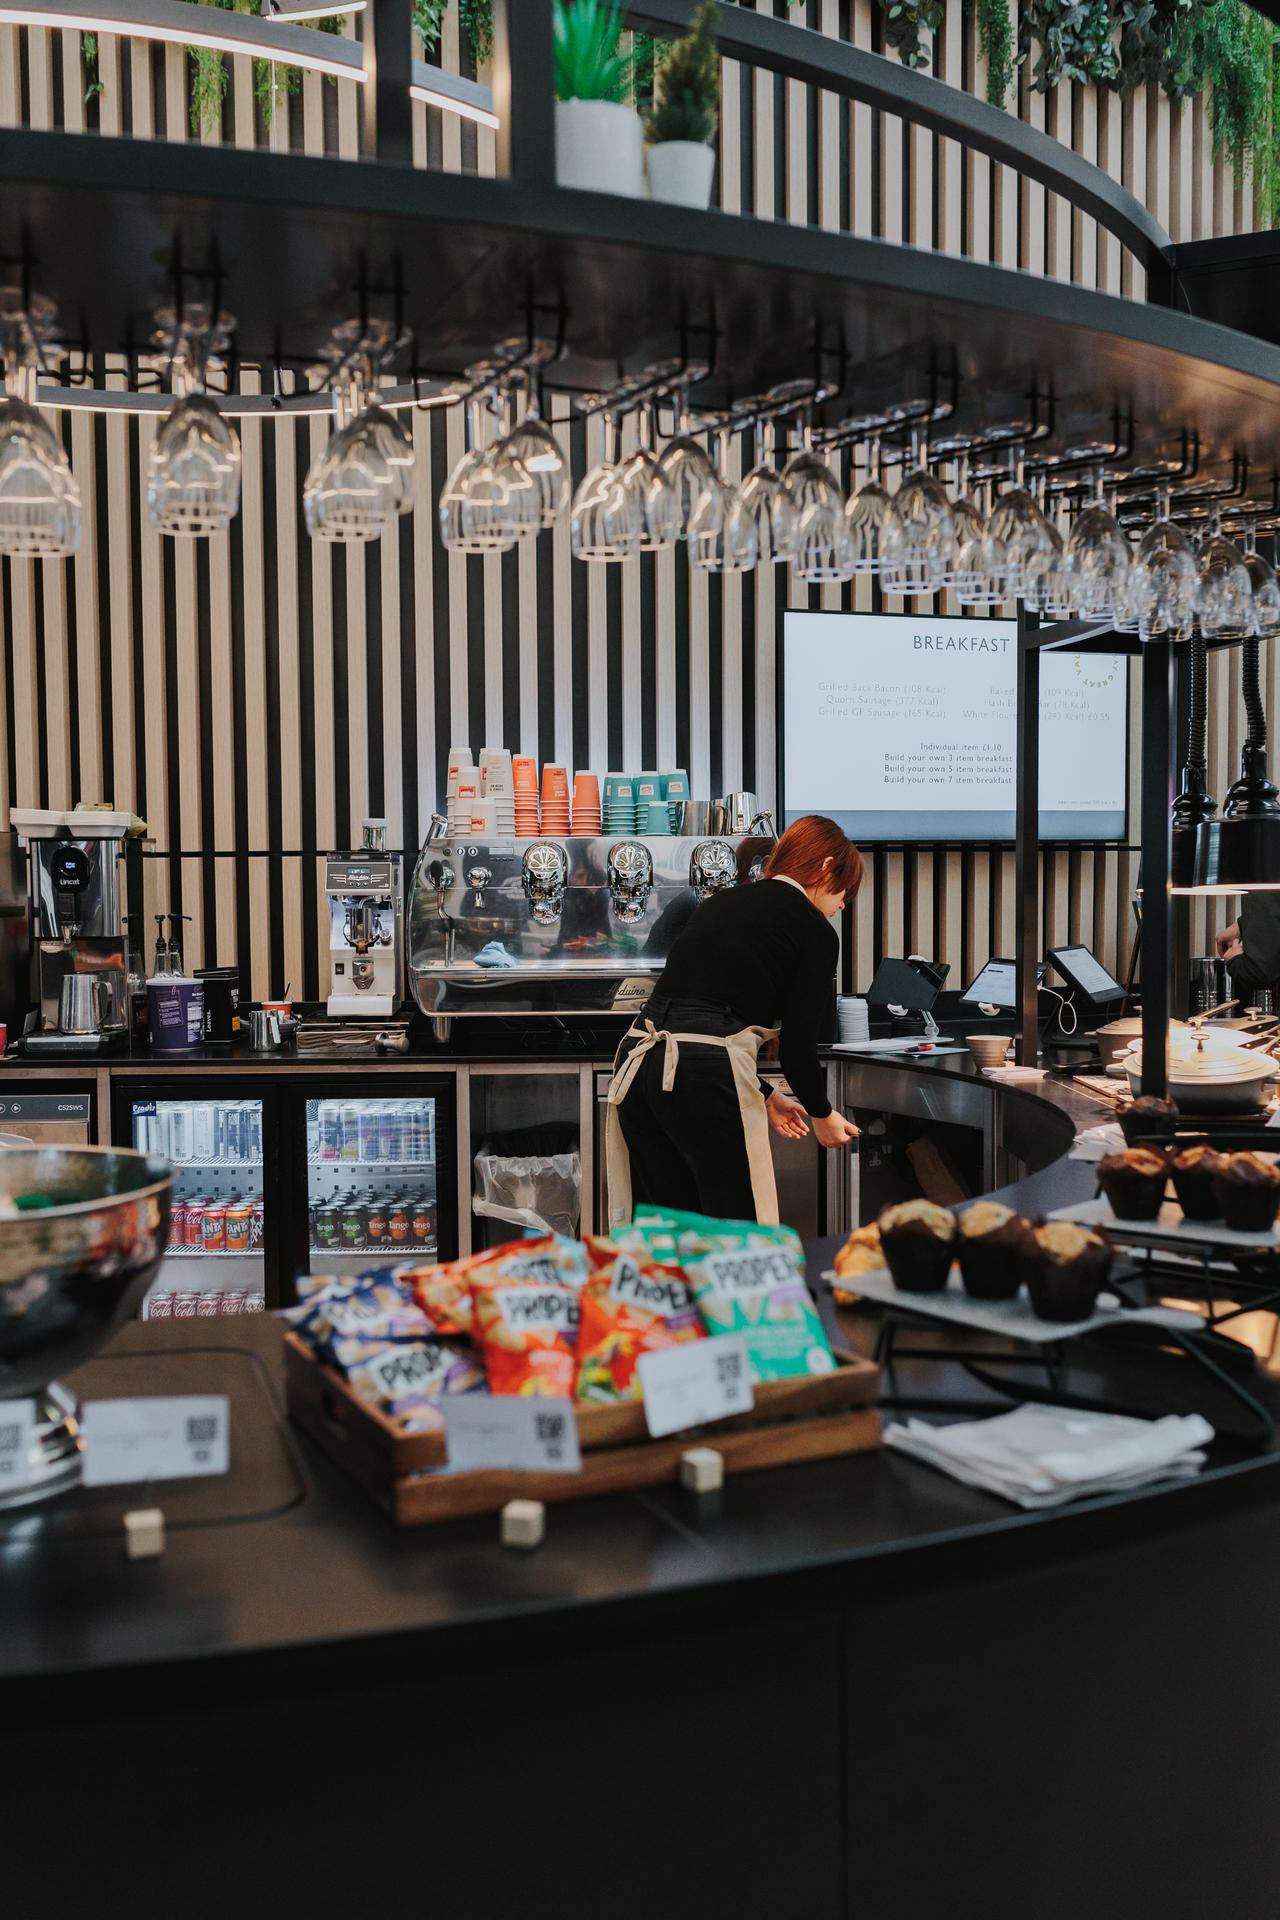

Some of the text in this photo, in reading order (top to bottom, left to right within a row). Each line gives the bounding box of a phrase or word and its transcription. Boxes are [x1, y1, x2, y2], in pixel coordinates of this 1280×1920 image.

[913, 635, 1010, 653] BREAKFAST
[875, 682, 901, 693] Bacon
[858, 695, 892, 706] Sausage
[920, 743, 959, 751] Individual
[962, 743, 979, 751] item
[884, 753, 905, 761] Build
[976, 754, 1013, 762] breakfast
[884, 764, 905, 772] Build
[976, 765, 1013, 773] breakfast
[884, 775, 905, 783] Build
[976, 776, 1013, 784] breakfast
[316, 1223, 334, 1232] Tango
[342, 1223, 360, 1232] Tango
[368, 1221, 386, 1230] Tango
[389, 1220, 410, 1230] Tango
[413, 1220, 431, 1229] Tango
